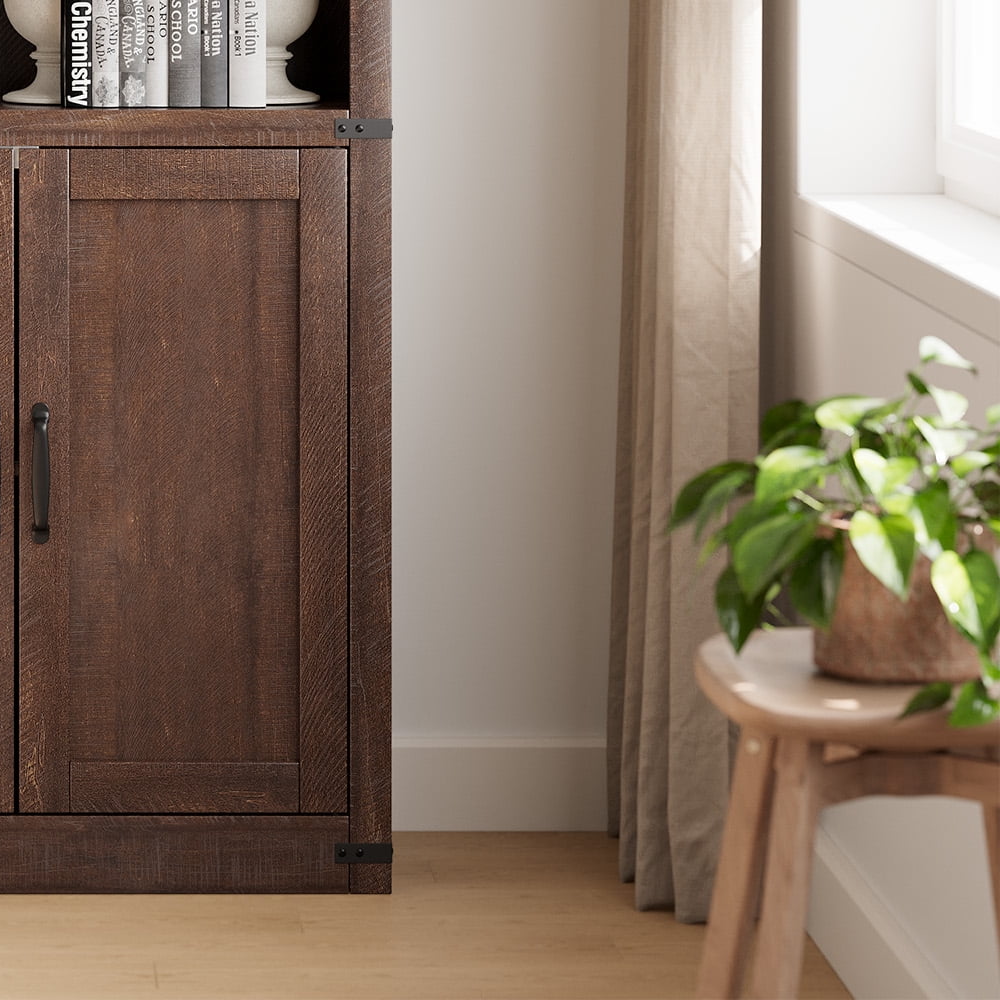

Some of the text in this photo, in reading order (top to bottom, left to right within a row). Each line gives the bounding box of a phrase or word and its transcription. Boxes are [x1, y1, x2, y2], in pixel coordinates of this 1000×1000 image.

[211, 1, 220, 9] a
[244, 1, 256, 9] a
[146, 5, 155, 65] SCHOOL
[171, 0, 182, 62] SCHOOL
[211, 12, 223, 57] Nation
[234, 35, 242, 51] Book
[244, 12, 260, 57] Nation
[68, 2, 92, 106] Chemistry
